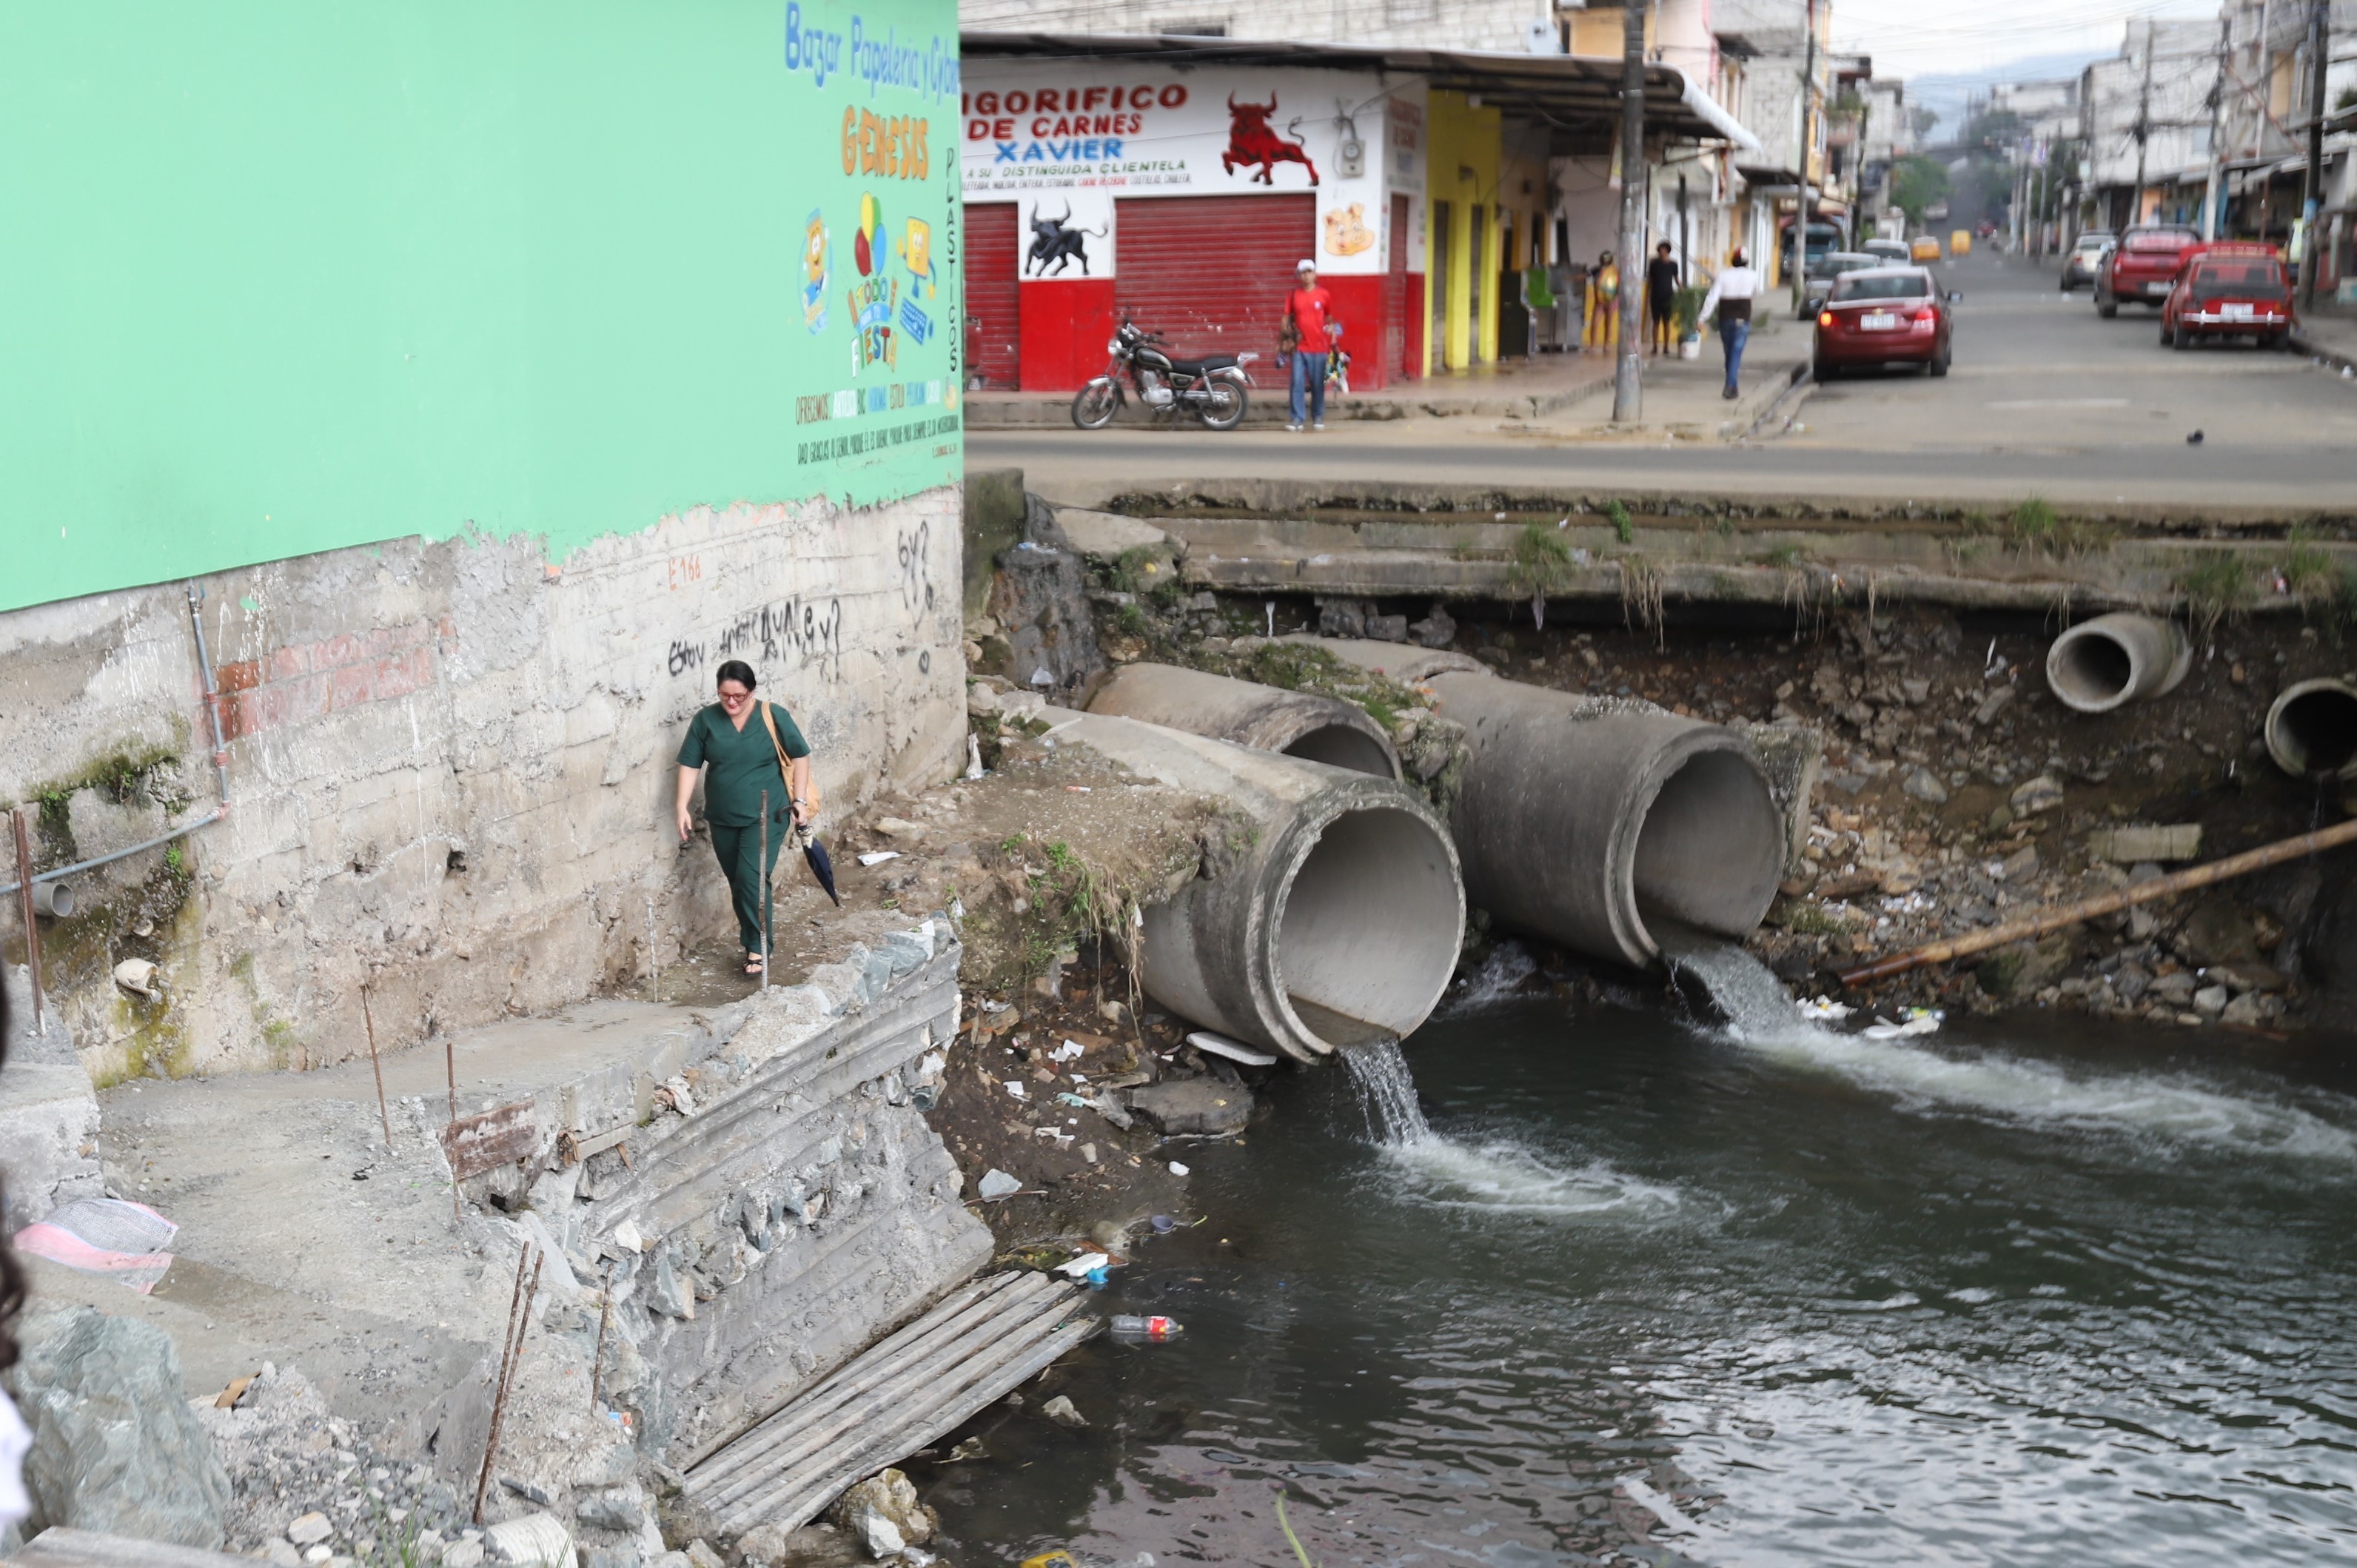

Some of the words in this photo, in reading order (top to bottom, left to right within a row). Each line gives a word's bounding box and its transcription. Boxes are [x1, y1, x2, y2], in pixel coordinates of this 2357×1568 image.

[785, 1, 842, 88] Bazar
[841, 104, 928, 180] GENESIS
[968, 118, 1016, 141] DE
[1031, 113, 1142, 138] CARNES
[994, 138, 1123, 164] XAVIER
[979, 168, 991, 178] SU
[1002, 164, 1092, 177] DISTINGUIDA
[1099, 159, 1186, 173] CLIENTELA
[856, 277, 887, 310] TODO
[851, 326, 897, 378] FIESTA
